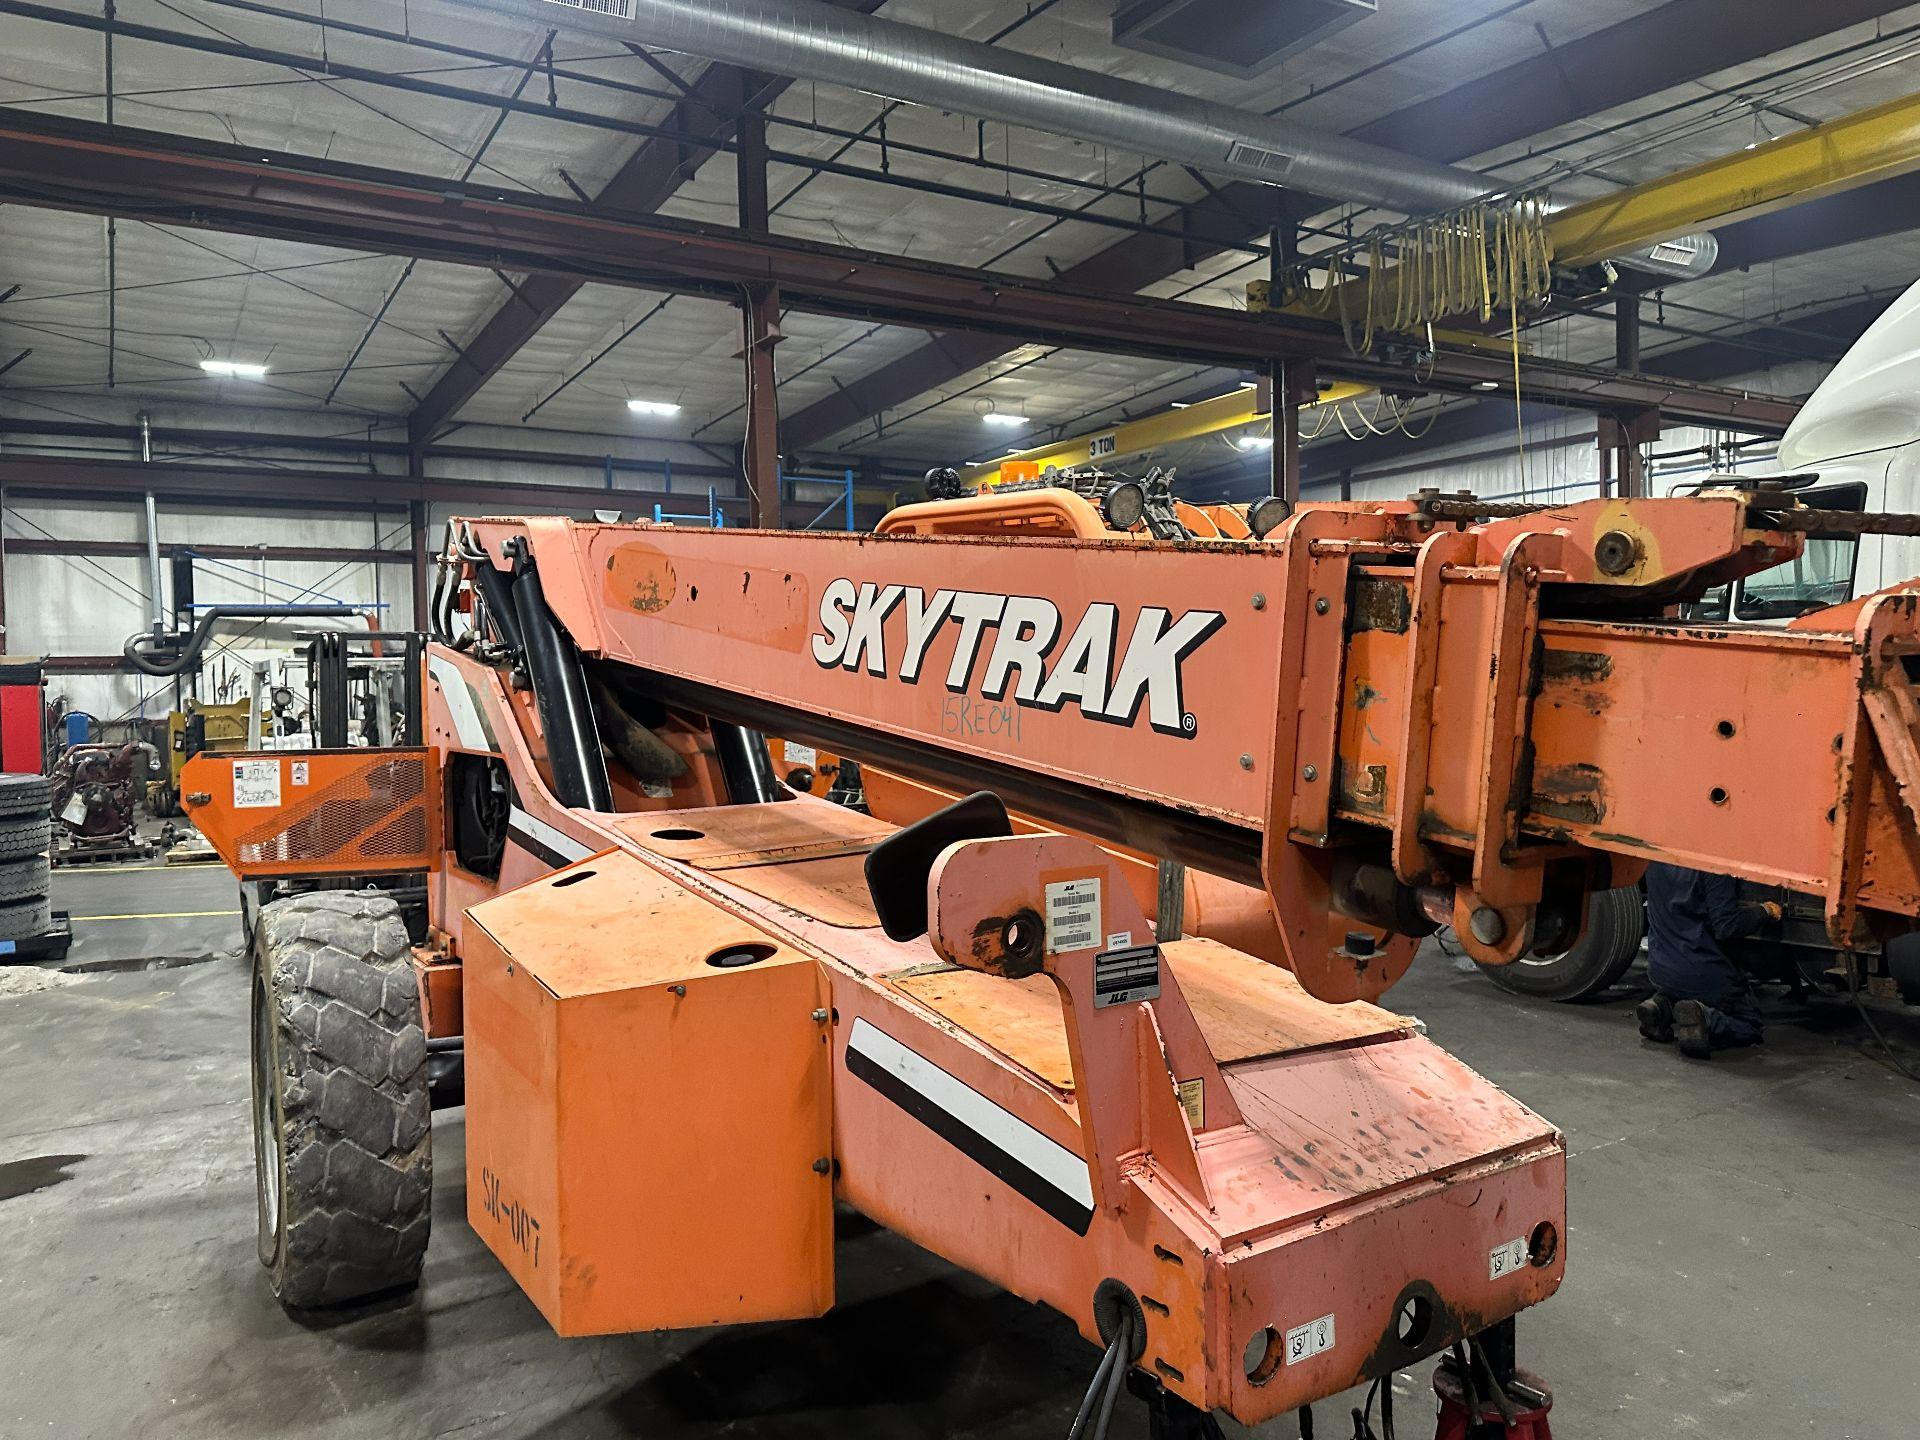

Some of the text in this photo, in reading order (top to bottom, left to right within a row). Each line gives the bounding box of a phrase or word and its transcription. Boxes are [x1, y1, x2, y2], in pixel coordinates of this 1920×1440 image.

[1090, 436, 1115, 456] 3 TON
[1108, 991, 1129, 1005] JLG
[482, 1166, 541, 1268] SK-007
